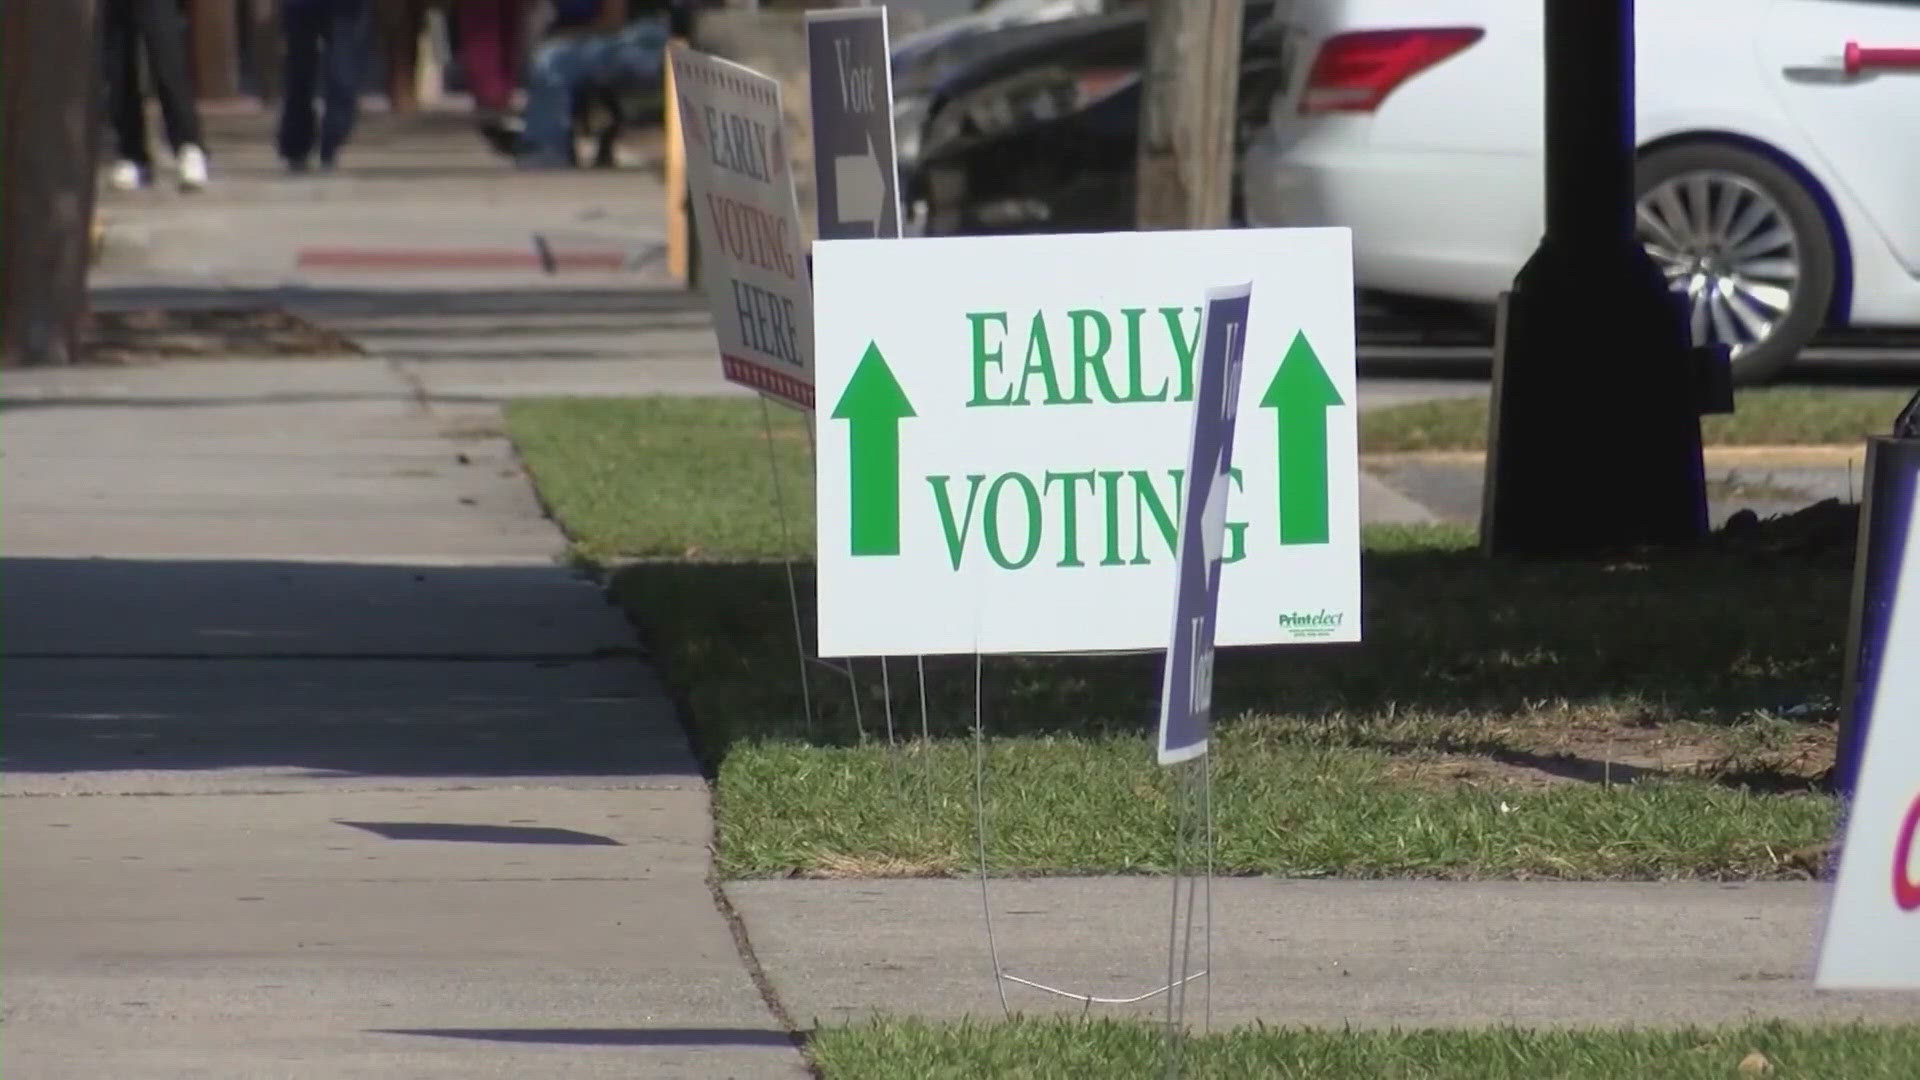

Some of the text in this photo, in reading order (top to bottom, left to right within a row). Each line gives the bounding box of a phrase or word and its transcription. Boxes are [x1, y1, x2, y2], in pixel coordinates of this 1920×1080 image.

[833, 38, 875, 114] Vote
[704, 105, 772, 184] EARLY
[706, 192, 796, 280] VOTING
[731, 279, 804, 368] HERE
[966, 306, 1202, 407] EARLY
